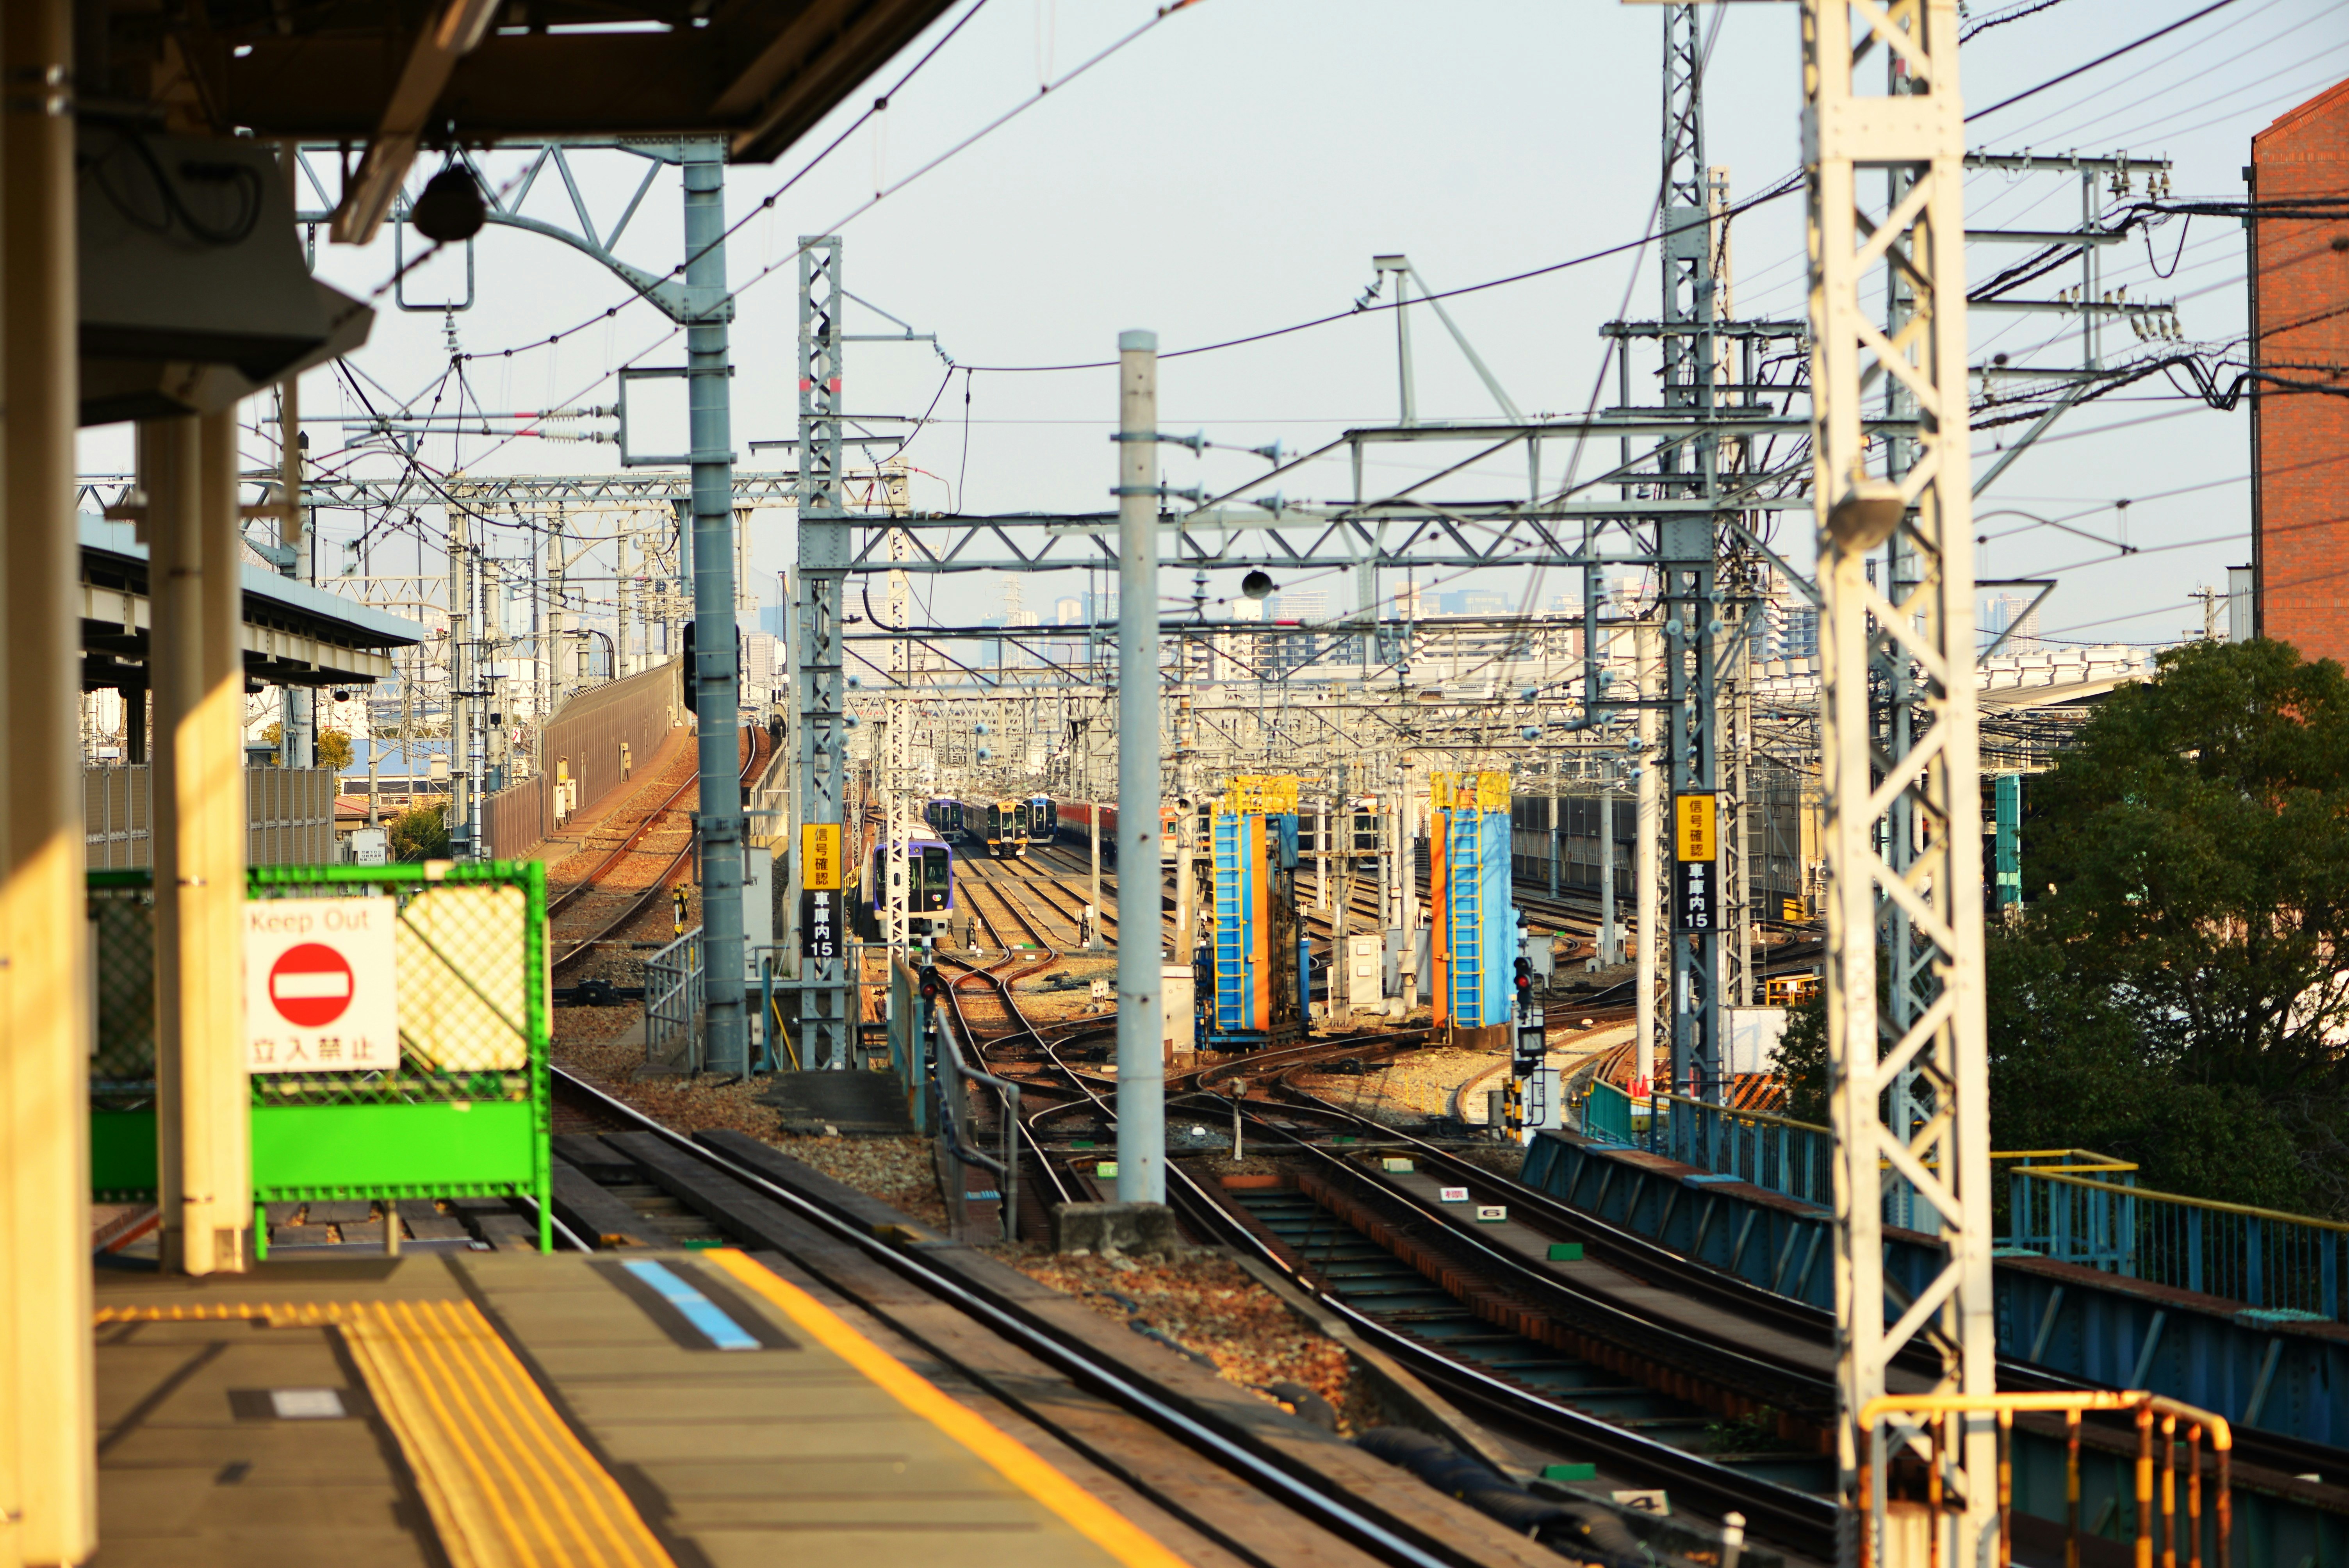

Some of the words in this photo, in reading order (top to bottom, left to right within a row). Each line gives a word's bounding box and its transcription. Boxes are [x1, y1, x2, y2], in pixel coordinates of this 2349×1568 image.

[815, 828, 829, 886] 信号確認
[1690, 800, 1704, 857] 信号確認
[251, 911, 313, 935] Keep
[324, 907, 369, 931] Out
[1686, 862, 1708, 927] 車庫内15
[810, 891, 833, 956] 車庫内15
[253, 1036, 376, 1064] 立入禁止
[1625, 1496, 1661, 1511] 4
